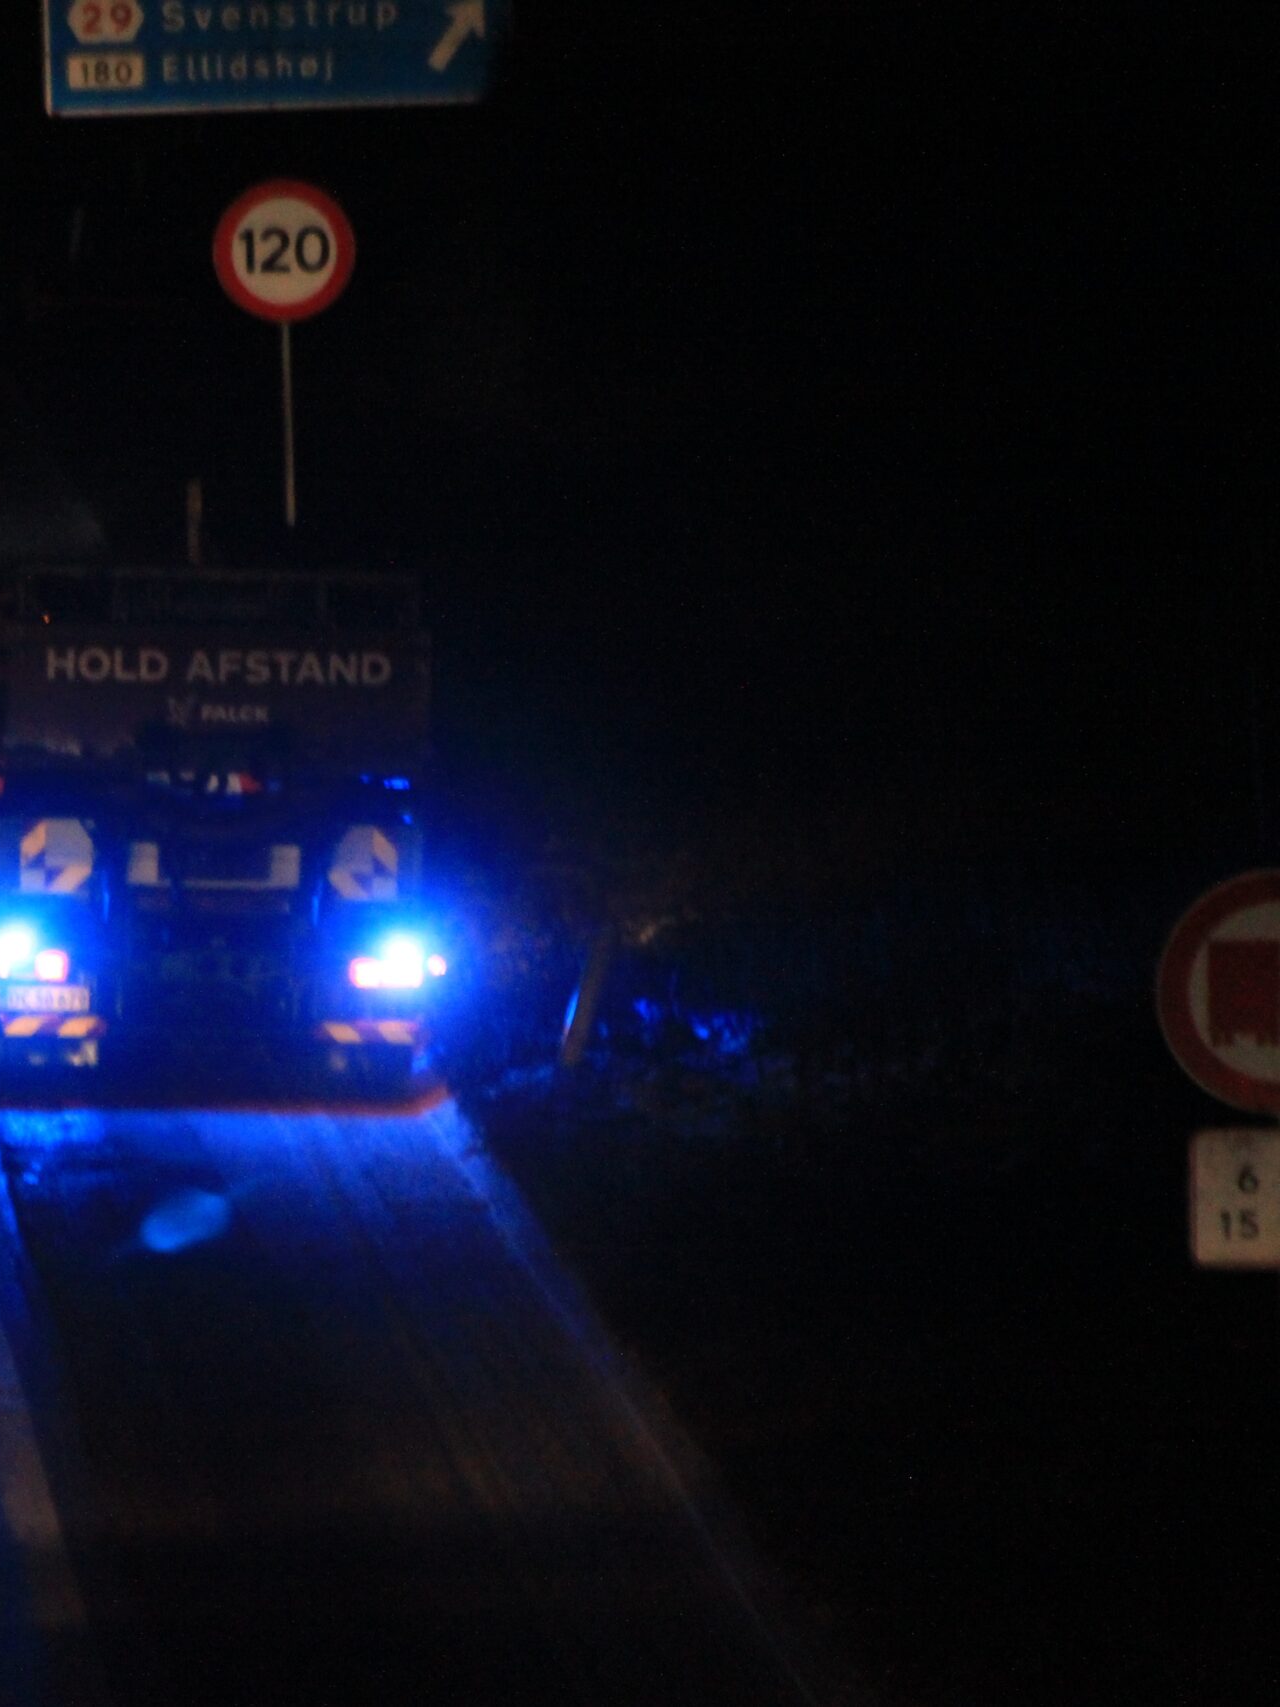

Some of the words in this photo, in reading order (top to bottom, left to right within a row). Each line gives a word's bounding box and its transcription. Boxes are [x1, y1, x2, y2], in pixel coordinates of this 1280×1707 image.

[81, 3, 133, 34] 29
[162, 0, 398, 32] Svenstrup
[81, 60, 133, 86] 180
[162, 51, 334, 82] Ellidshøj
[238, 225, 331, 275] 120
[45, 646, 169, 683] HOLD
[185, 648, 393, 686] AFSTAND
